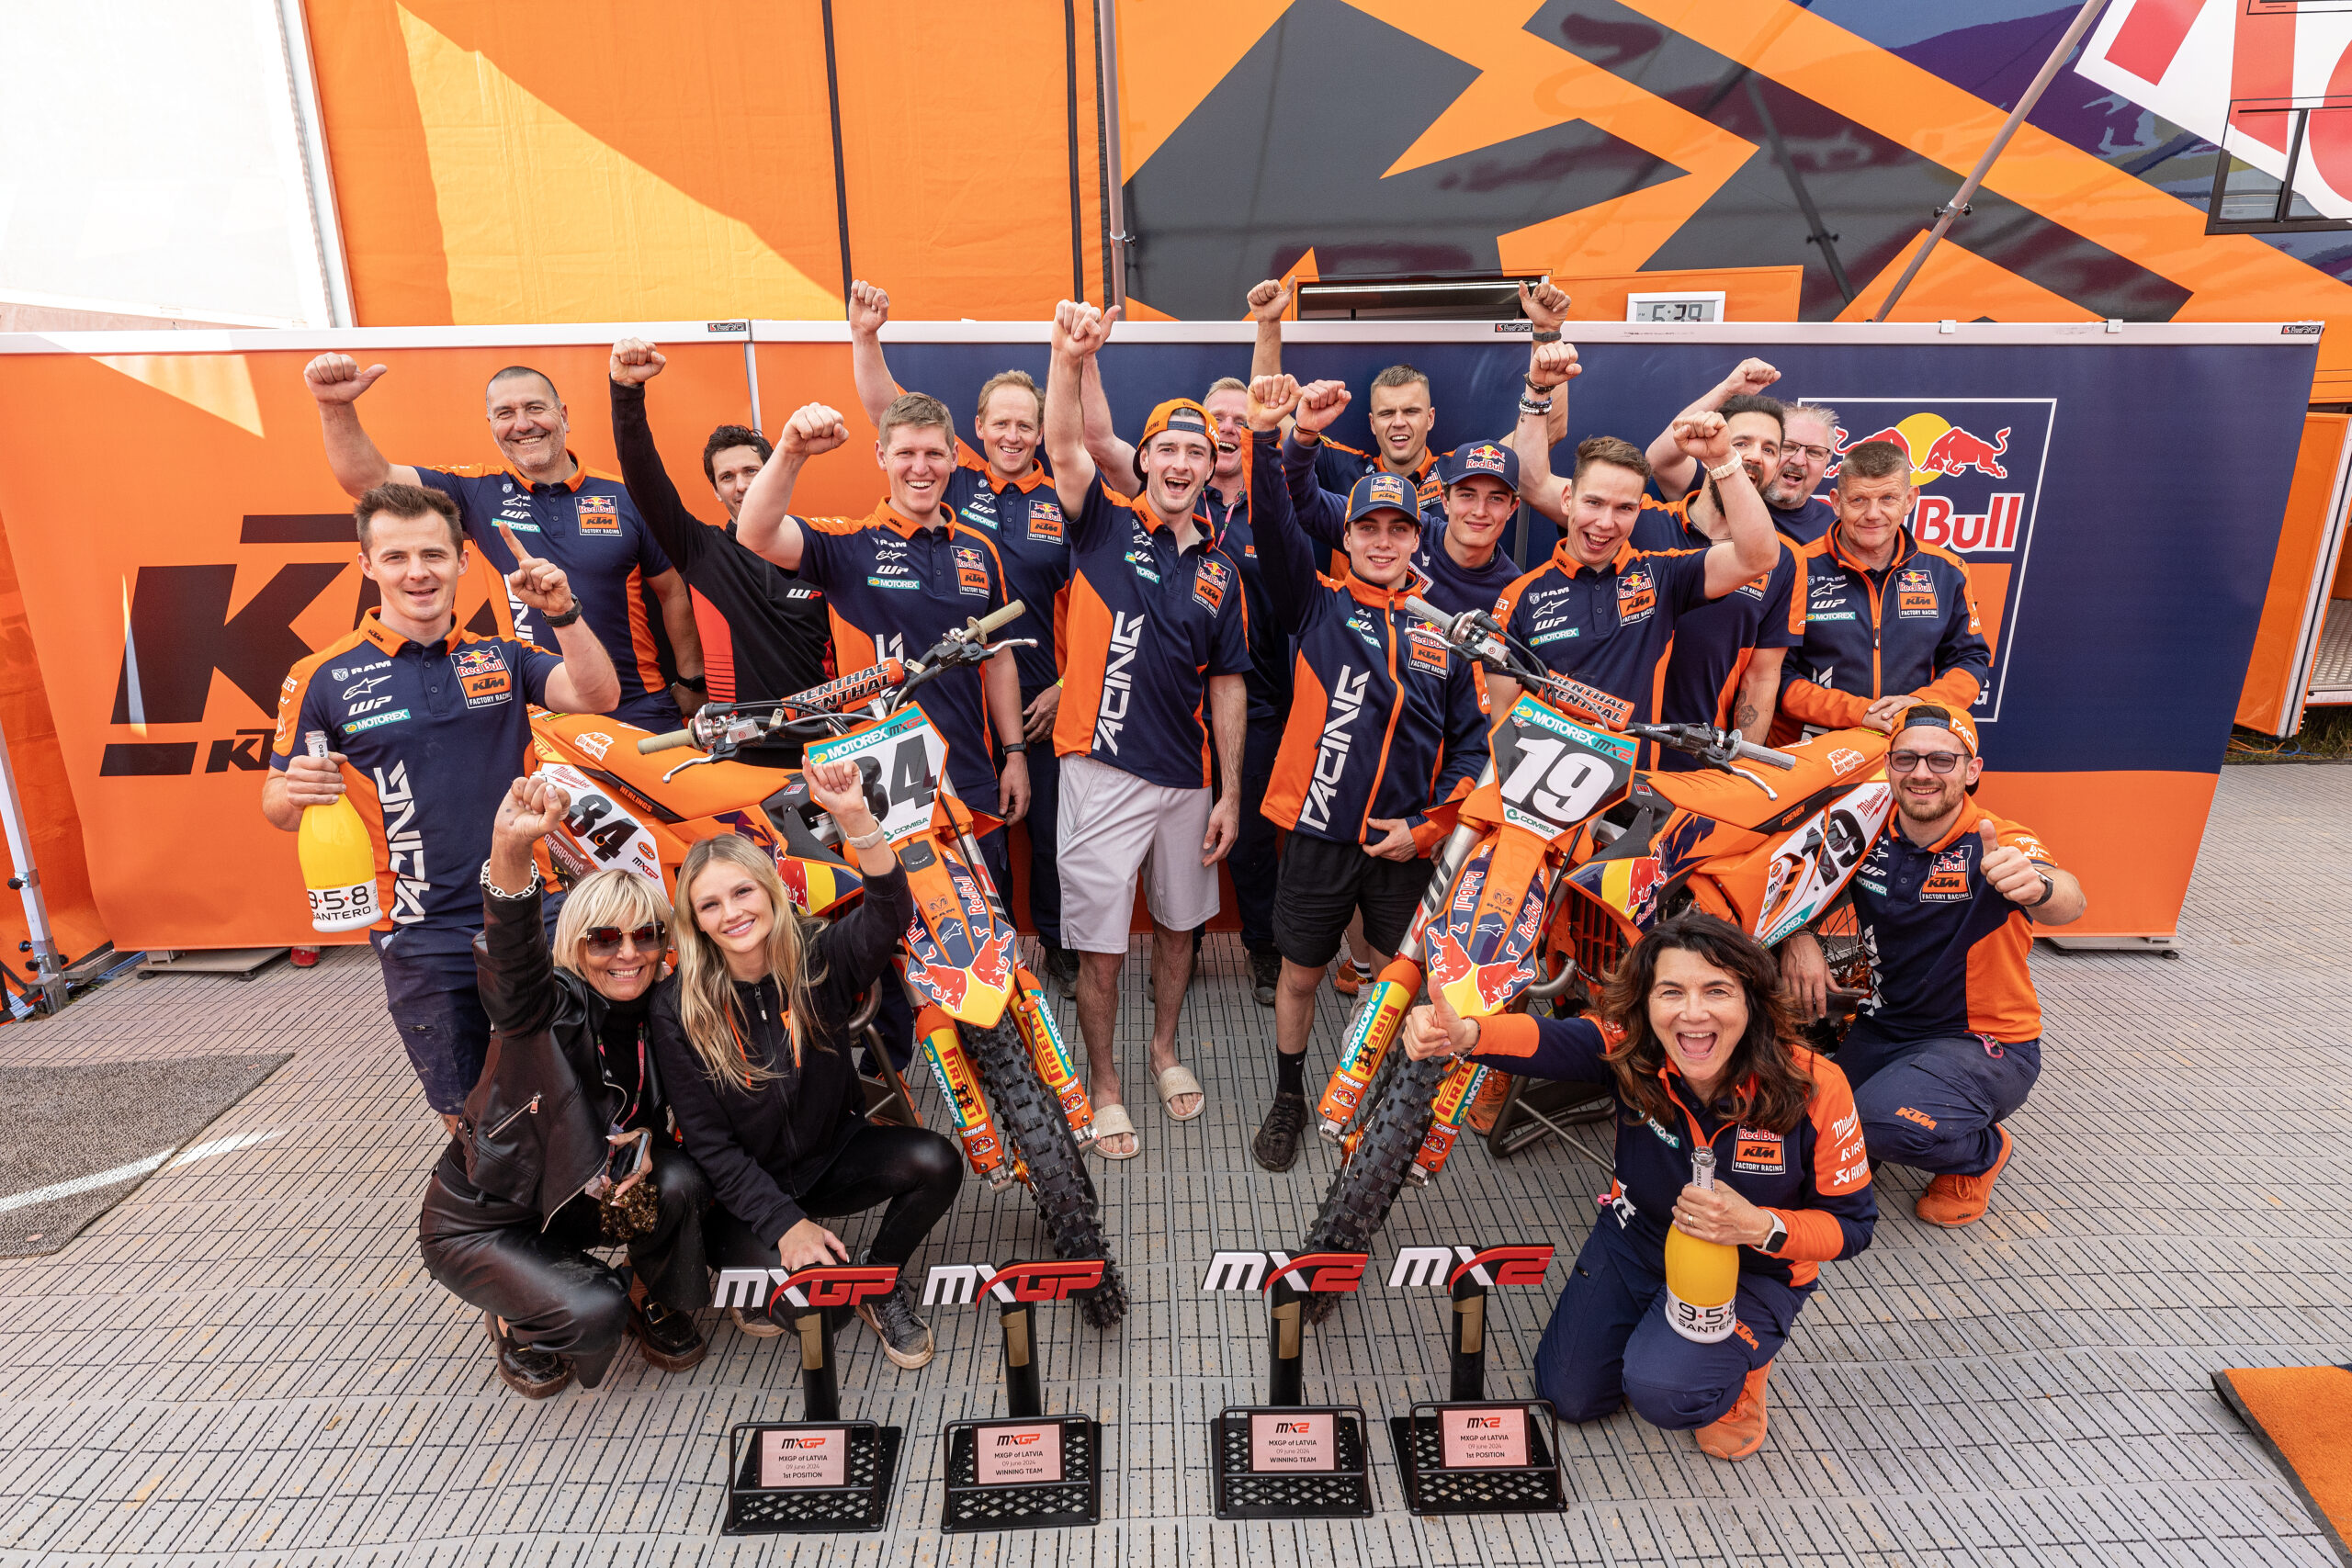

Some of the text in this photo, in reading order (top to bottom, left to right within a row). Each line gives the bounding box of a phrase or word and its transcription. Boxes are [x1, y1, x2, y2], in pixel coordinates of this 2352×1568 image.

[1466, 459, 1505, 473] Red Bull
[1388, 484, 1402, 494] Bull
[501, 509, 531, 519] WP
[579, 505, 616, 514] Red Bull
[969, 502, 997, 513] WP
[586, 516, 613, 525] KTM
[888, 518, 902, 529] KTM
[967, 513, 997, 528] MOTOREX
[1030, 510, 1062, 522] Red Bull
[1916, 493, 2025, 552] Bull
[1035, 523, 1057, 532] KTM
[876, 565, 910, 574] WP
[1556, 558, 1567, 570] KTM
[880, 579, 918, 590] MOTOREX
[965, 573, 986, 584] KTM
[1198, 567, 1227, 591] Red Bull
[786, 588, 822, 599] WP
[1200, 585, 1219, 602] KTM
[1540, 586, 1570, 599] RAM
[1619, 577, 1653, 599] Red Bull
[1899, 582, 1932, 592] Red Bull
[1626, 595, 1650, 612] KTM
[1812, 599, 1847, 609] WP
[1905, 596, 1931, 605] KTM
[1534, 616, 1568, 631] WP
[1816, 612, 1854, 620] MOTOREX
[368, 629, 384, 643] KTM
[1539, 629, 1578, 643] MOTOREX
[1418, 649, 1442, 661] KTM
[351, 660, 391, 675] RAM
[458, 660, 504, 677] Red Bull
[1410, 660, 1446, 676] FACTORY RACING
[472, 677, 505, 691] KTM
[790, 662, 889, 704] RENTHAL
[1093, 611, 1145, 756] RACING
[348, 695, 392, 716] WP
[469, 695, 494, 705] FACTORY
[357, 710, 407, 729] MOTOREX
[827, 716, 923, 760] MOTOREX MXGP
[1532, 711, 1634, 761] MOTOREX MX2
[1299, 665, 1371, 831] RACING
[551, 765, 591, 789] Milwaukee
[1500, 737, 1614, 822] 19
[619, 785, 653, 813] HERLINGS
[1857, 784, 1888, 817] Milwaukee
[1782, 805, 1805, 826] COENEN
[563, 794, 639, 863] 84
[893, 817, 929, 835] COMISA
[1520, 815, 1555, 836] COMISA
[1802, 808, 1866, 887] 19
[632, 856, 660, 880] MXGP
[1944, 860, 1965, 871] Bull
[1769, 873, 1783, 894] MX2
[1928, 877, 1960, 888] KTM
[1948, 892, 1969, 900] RACING
[932, 908, 956, 920] RAM
[1487, 903, 1512, 916] RAM
[1767, 914, 1805, 945] MOTOREX
[1038, 993, 1067, 1056] MOTOREX
[1342, 1002, 1376, 1066] MOTOREX
[1336, 1070, 1364, 1089] SCRUB
[930, 1062, 962, 1124] MOTOREX
[1894, 1107, 1938, 1131] KTM
[960, 1122, 987, 1138] SCRUB
[1431, 1120, 1459, 1136] SCRUB
[1739, 1129, 1781, 1141] Red Bull
[1743, 1146, 1775, 1158] KTM
[1736, 1163, 1759, 1171] FACTORY
[1202, 1250, 1369, 1299] MX2
[1386, 1244, 1555, 1294] MX2
[714, 1264, 900, 1316] MXGP
[922, 1260, 1105, 1312] MXGP
[1276, 1423, 1310, 1434] MX2
[1467, 1417, 1501, 1429] MX2
[781, 1438, 826, 1449] MXGP
[997, 1434, 1040, 1446] MXGP
